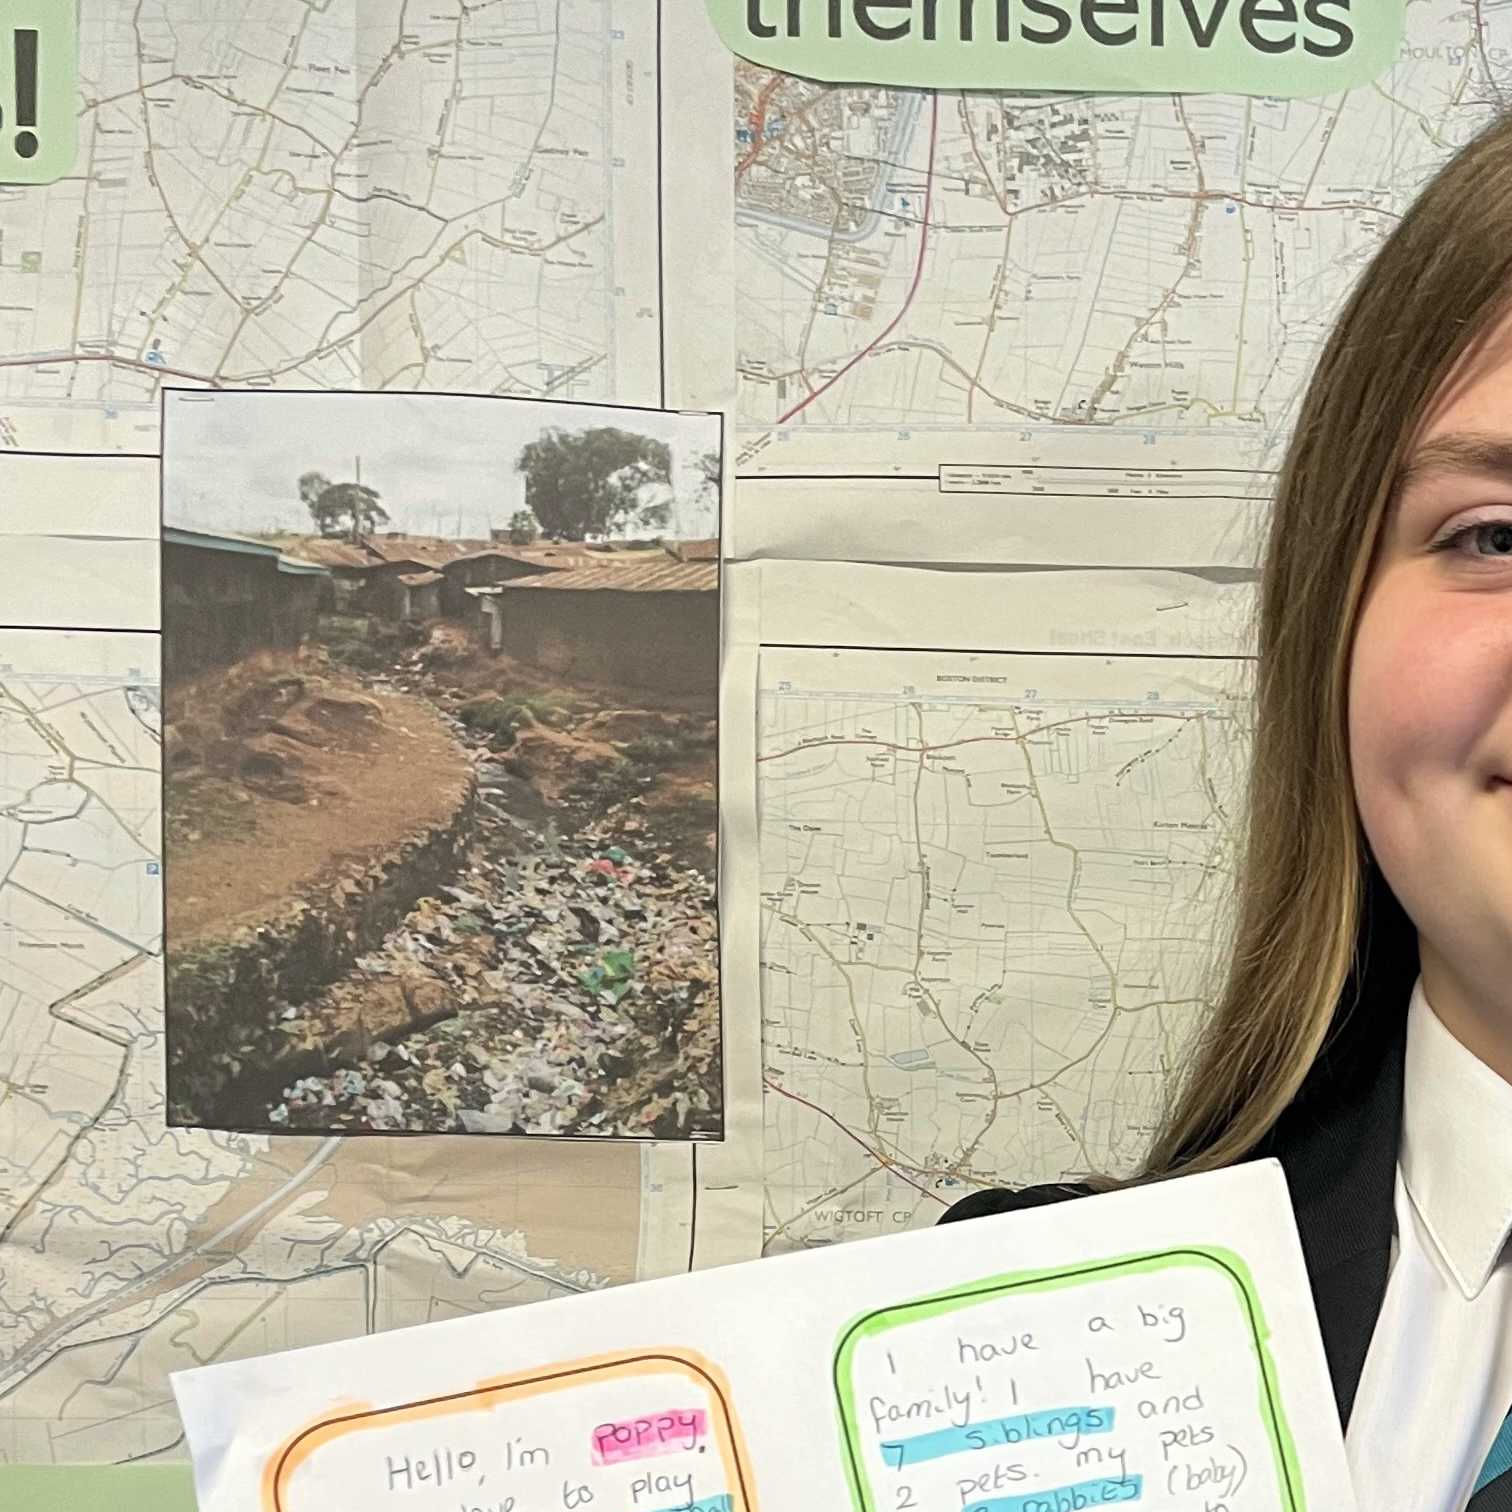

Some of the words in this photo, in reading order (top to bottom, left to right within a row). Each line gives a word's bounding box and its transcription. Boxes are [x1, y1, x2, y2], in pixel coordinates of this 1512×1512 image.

[958, 1333, 1039, 1364] have
[1088, 1315, 1115, 1332] a
[1138, 1304, 1186, 1343] big
[869, 1375, 984, 1434] family!
[1086, 1357, 1162, 1394] have
[881, 1442, 905, 1471] 7
[965, 1409, 1105, 1450] siblings
[1137, 1385, 1204, 1419] and
[386, 1447, 487, 1490] Hello,
[563, 1480, 594, 1510] to
[631, 1473, 695, 1511] play
[896, 1485, 918, 1510] 2
[1075, 1447, 1126, 1489] my
[1159, 1424, 1215, 1461] pets
[1167, 1443, 1248, 1500] (baby)
